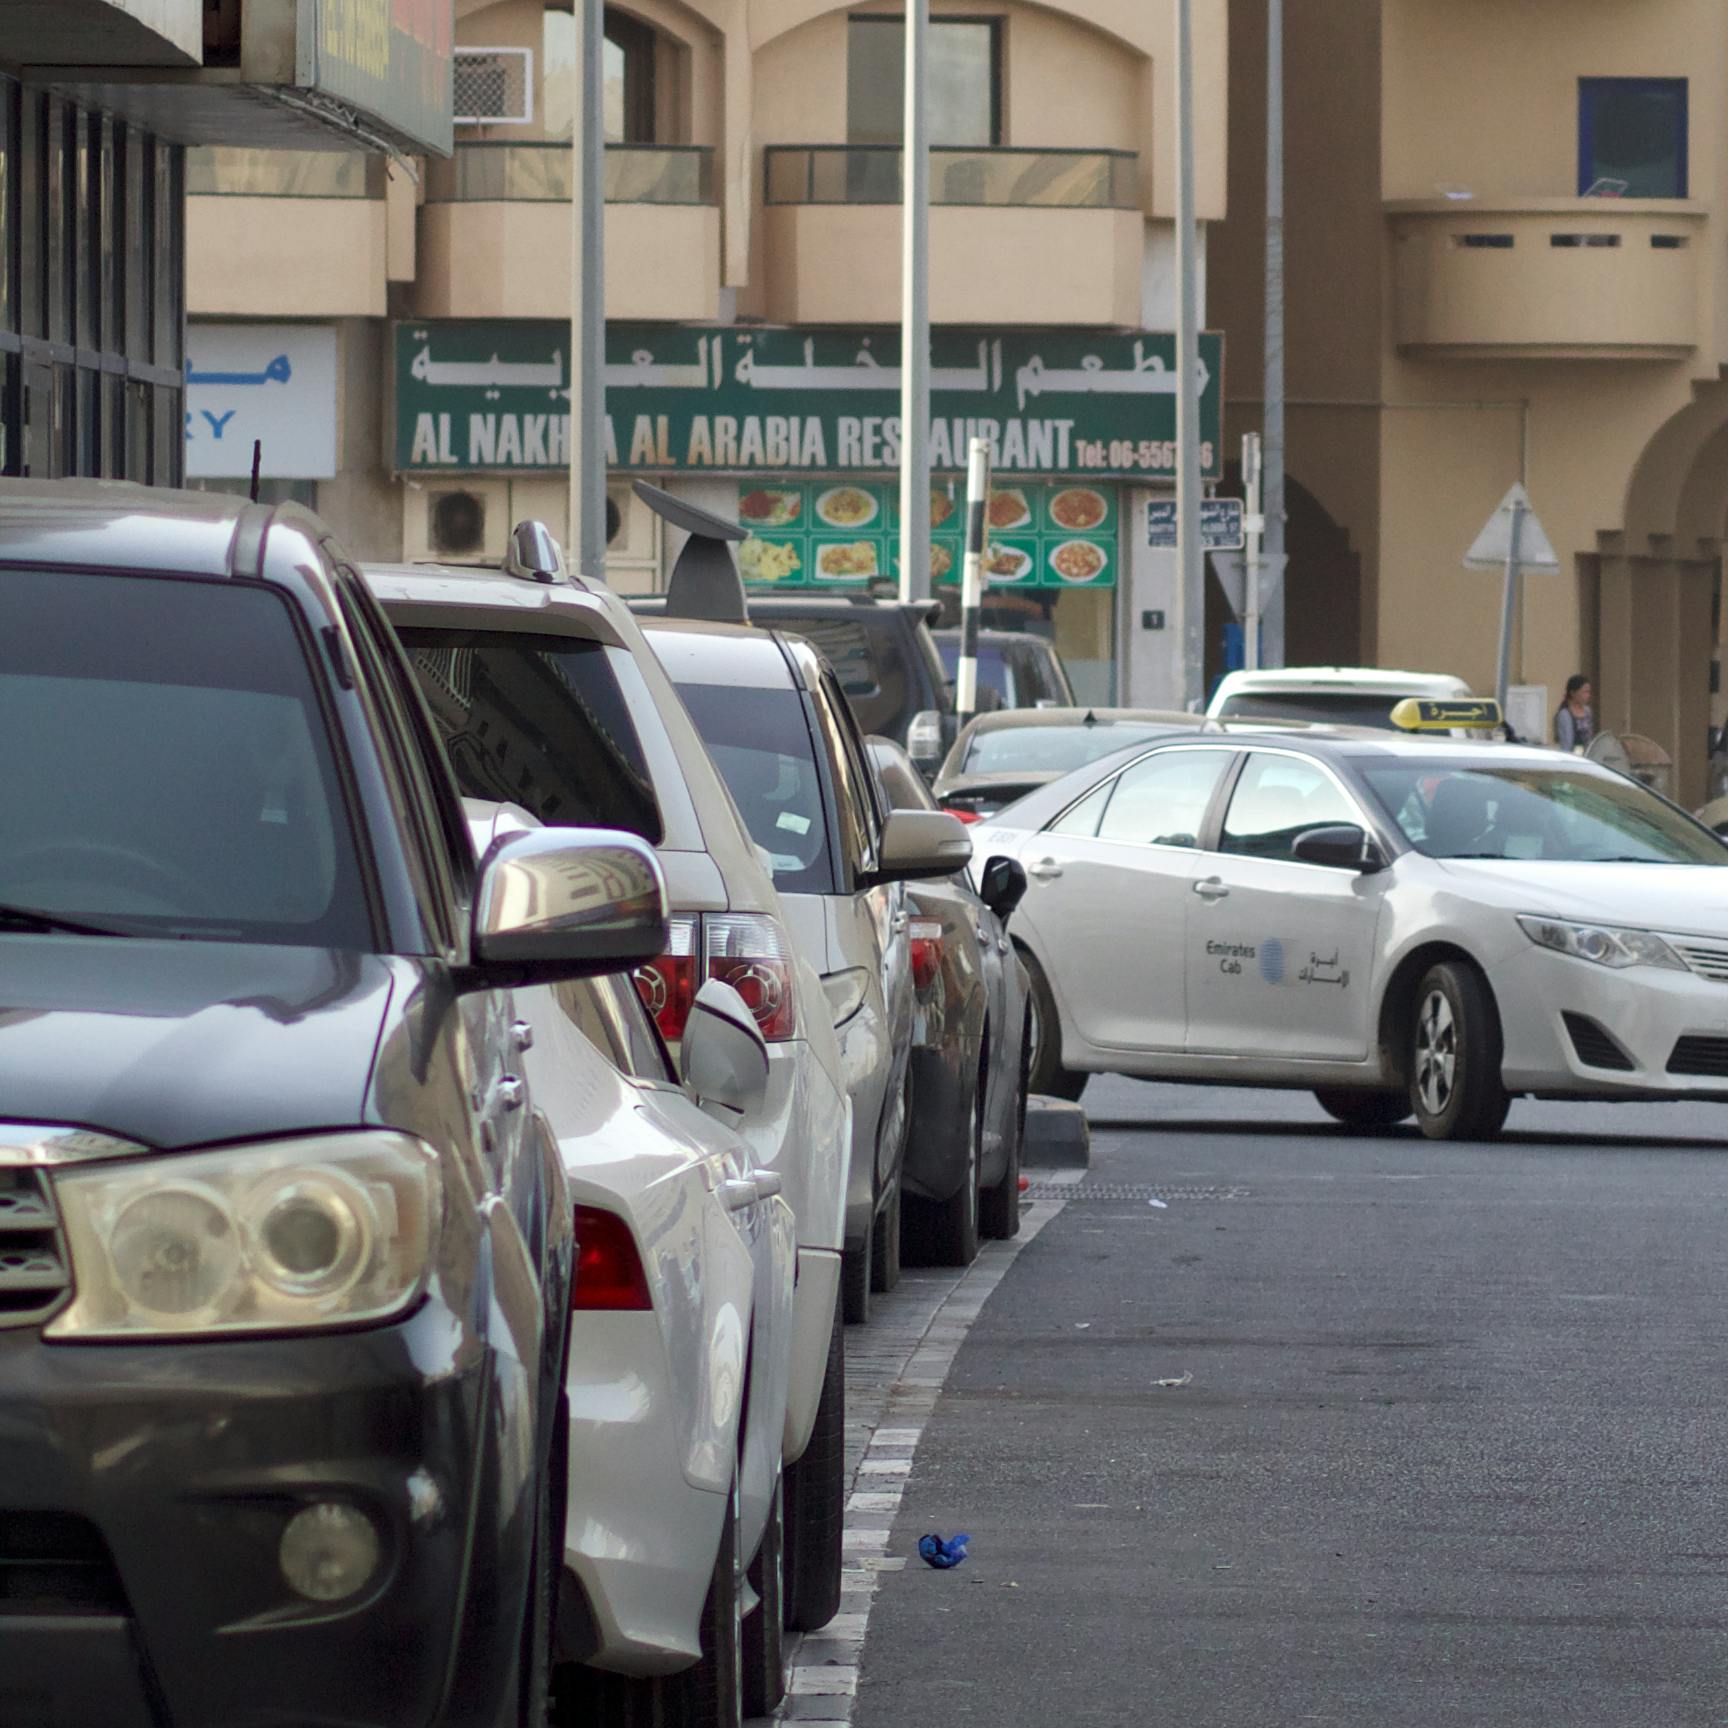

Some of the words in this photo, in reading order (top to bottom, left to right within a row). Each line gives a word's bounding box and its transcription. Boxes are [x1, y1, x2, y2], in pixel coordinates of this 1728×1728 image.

[411, 413, 459, 465] AL
[469, 414, 618, 465] NAKHA
[630, 414, 677, 466] AL
[687, 415, 827, 467] ARABIA
[837, 416, 1075, 469] RESAURANT
[1076, 440, 1106, 468] Tel:
[1206, 940, 1256, 958] Emirates
[1219, 957, 1242, 975] Cab
